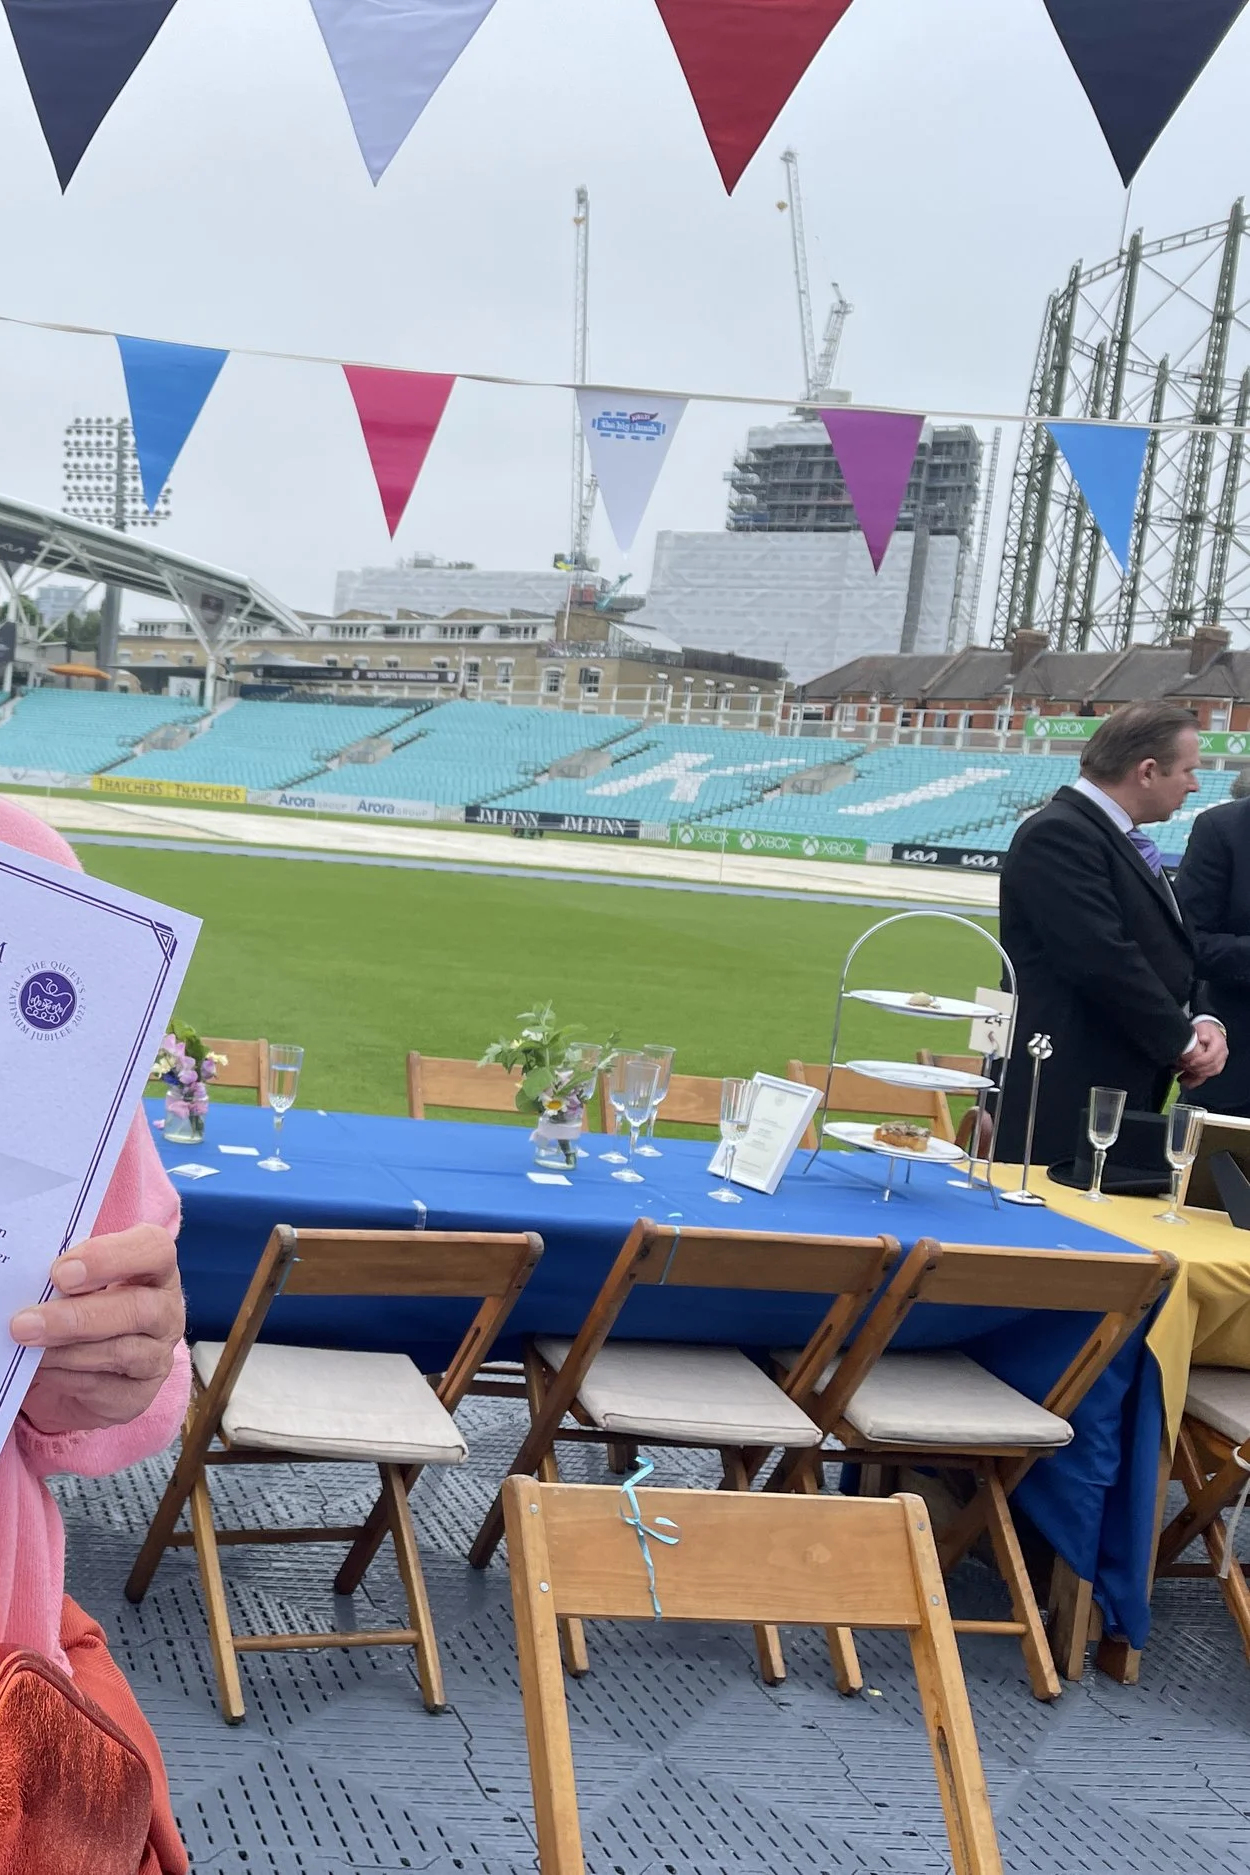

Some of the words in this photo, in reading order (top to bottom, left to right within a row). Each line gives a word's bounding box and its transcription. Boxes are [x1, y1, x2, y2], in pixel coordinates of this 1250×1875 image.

[1053, 722, 1086, 735] XBOX
[1199, 737, 1214, 749] OX
[97, 778, 163, 794] THATCHERS
[173, 783, 241, 801] THATCHERS
[278, 794, 316, 808] Arora
[357, 800, 396, 815] Arora
[498, 810, 540, 827] FINN
[584, 817, 626, 836] FINN
[696, 830, 729, 845] XBOX
[758, 835, 791, 851] XBOX
[822, 841, 857, 856] XBOX
[25, 960, 47, 974] THE
[72, 1004, 86, 1026] 2022
[9, 980, 30, 1034] PLATINUM
[30, 1025, 72, 1041] JUBILEE
